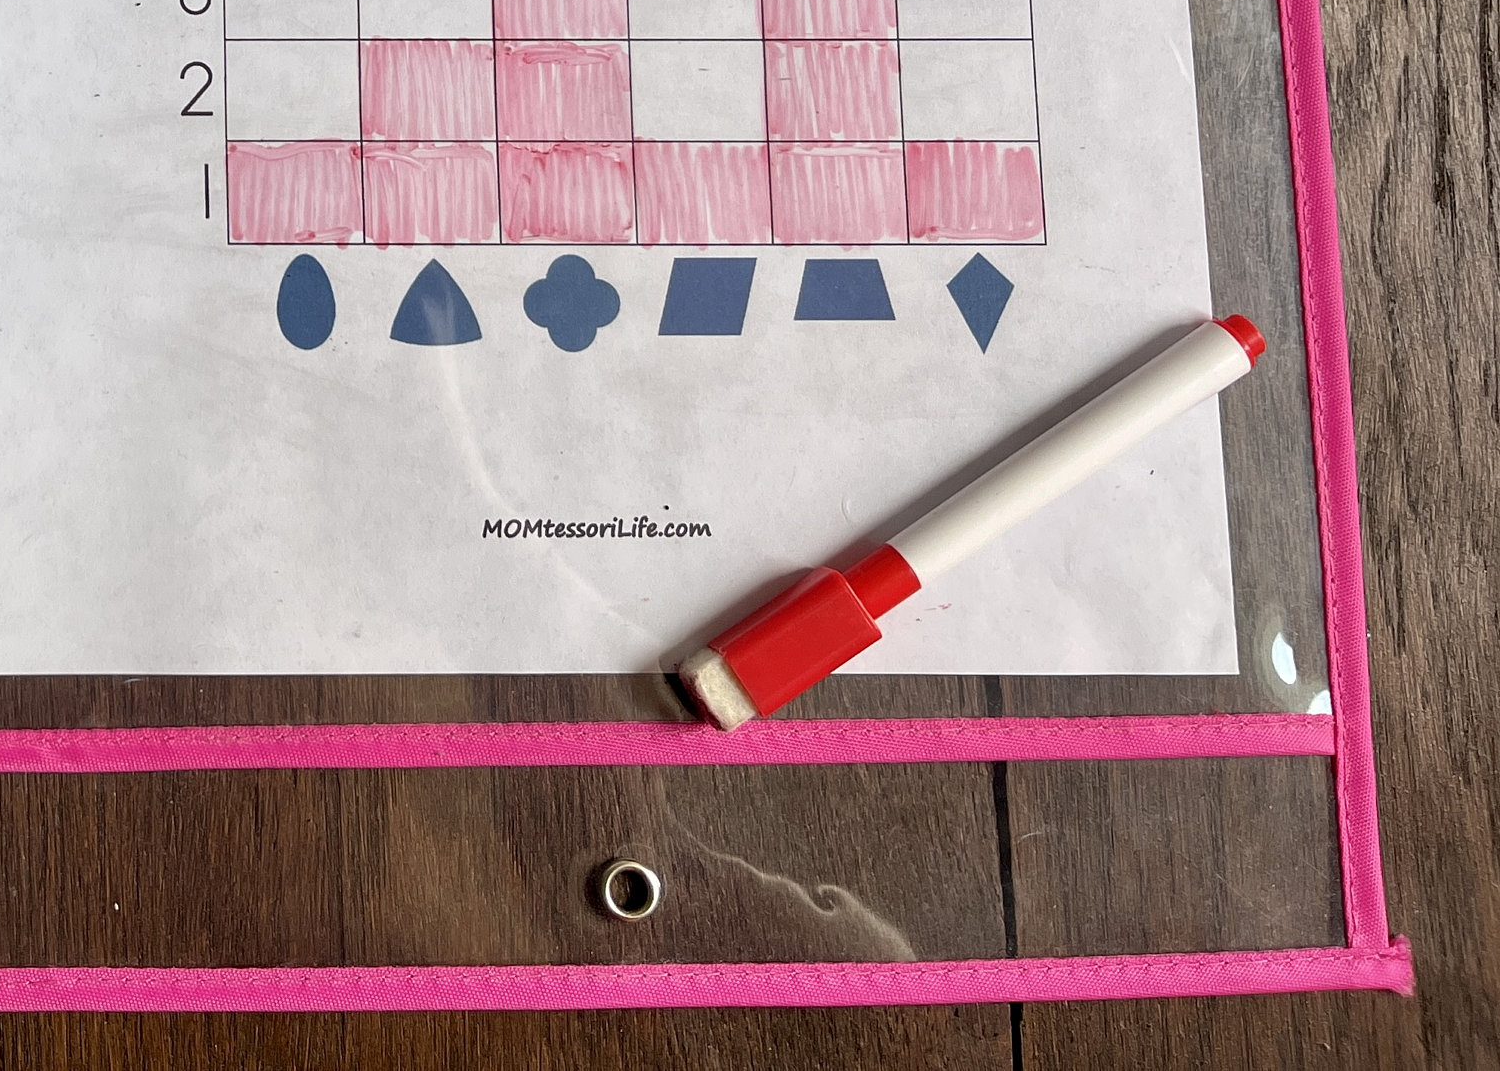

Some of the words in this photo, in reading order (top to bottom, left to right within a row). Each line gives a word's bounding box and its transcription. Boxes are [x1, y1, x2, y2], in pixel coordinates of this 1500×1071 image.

[179, 61, 214, 117] 2
[203, 163, 211, 219] 1
[482, 515, 712, 539] MOMtessoriLife.com
